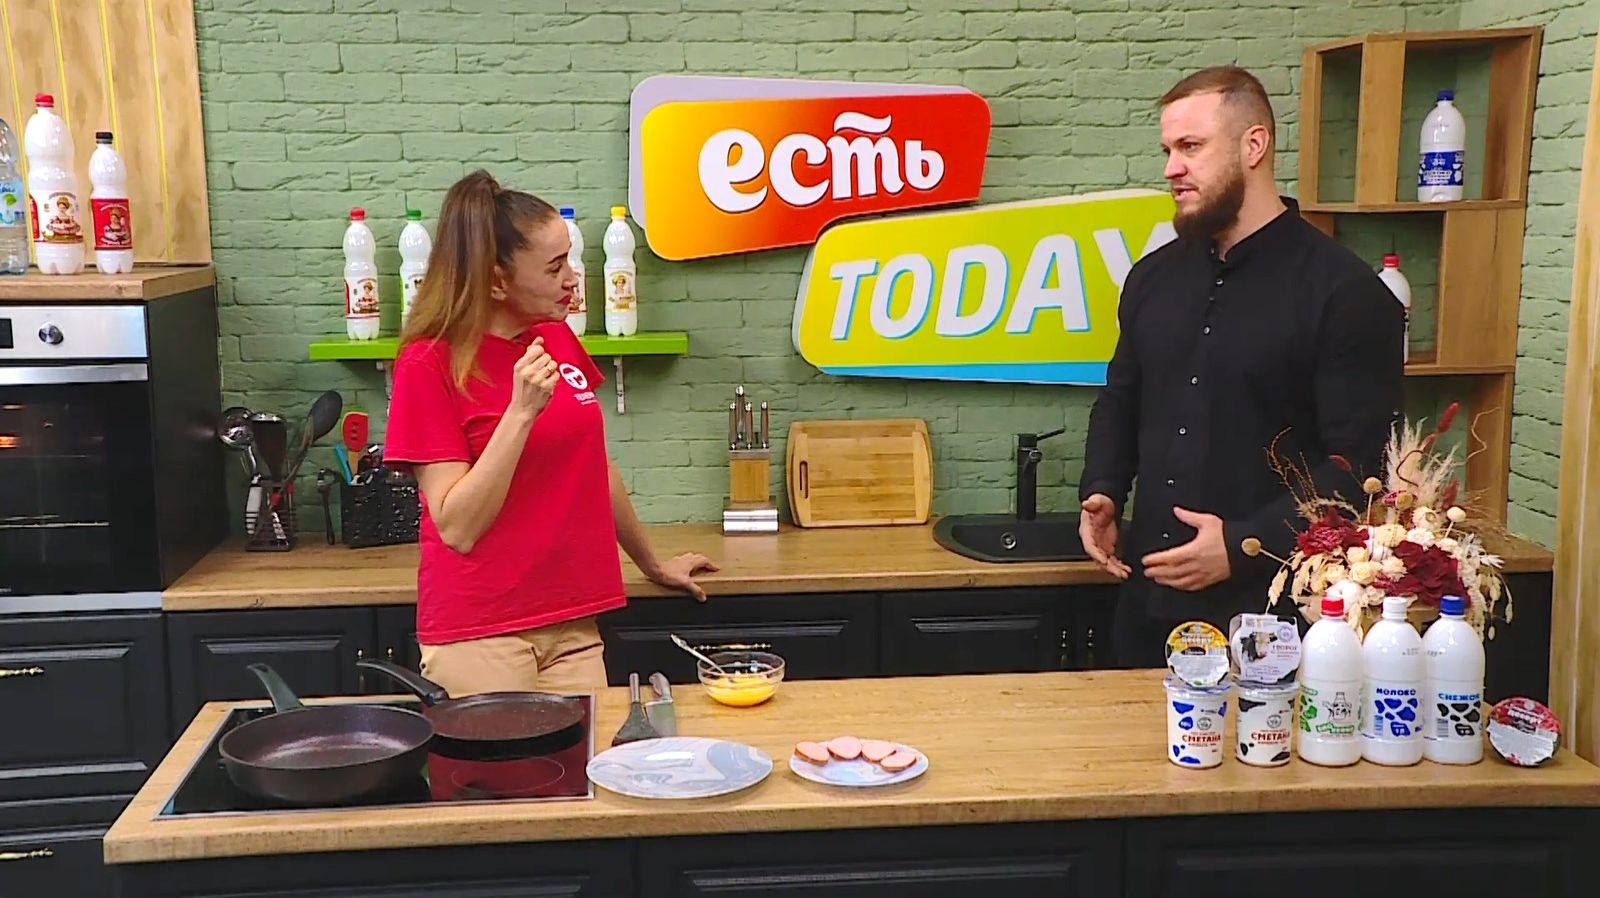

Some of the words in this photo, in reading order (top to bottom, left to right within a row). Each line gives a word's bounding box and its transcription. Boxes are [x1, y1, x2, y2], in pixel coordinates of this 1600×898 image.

[698, 112, 945, 213] есть
[1376, 687, 1417, 696] МОЛОКО
[1181, 733, 1221, 743] СМЕТАНА
